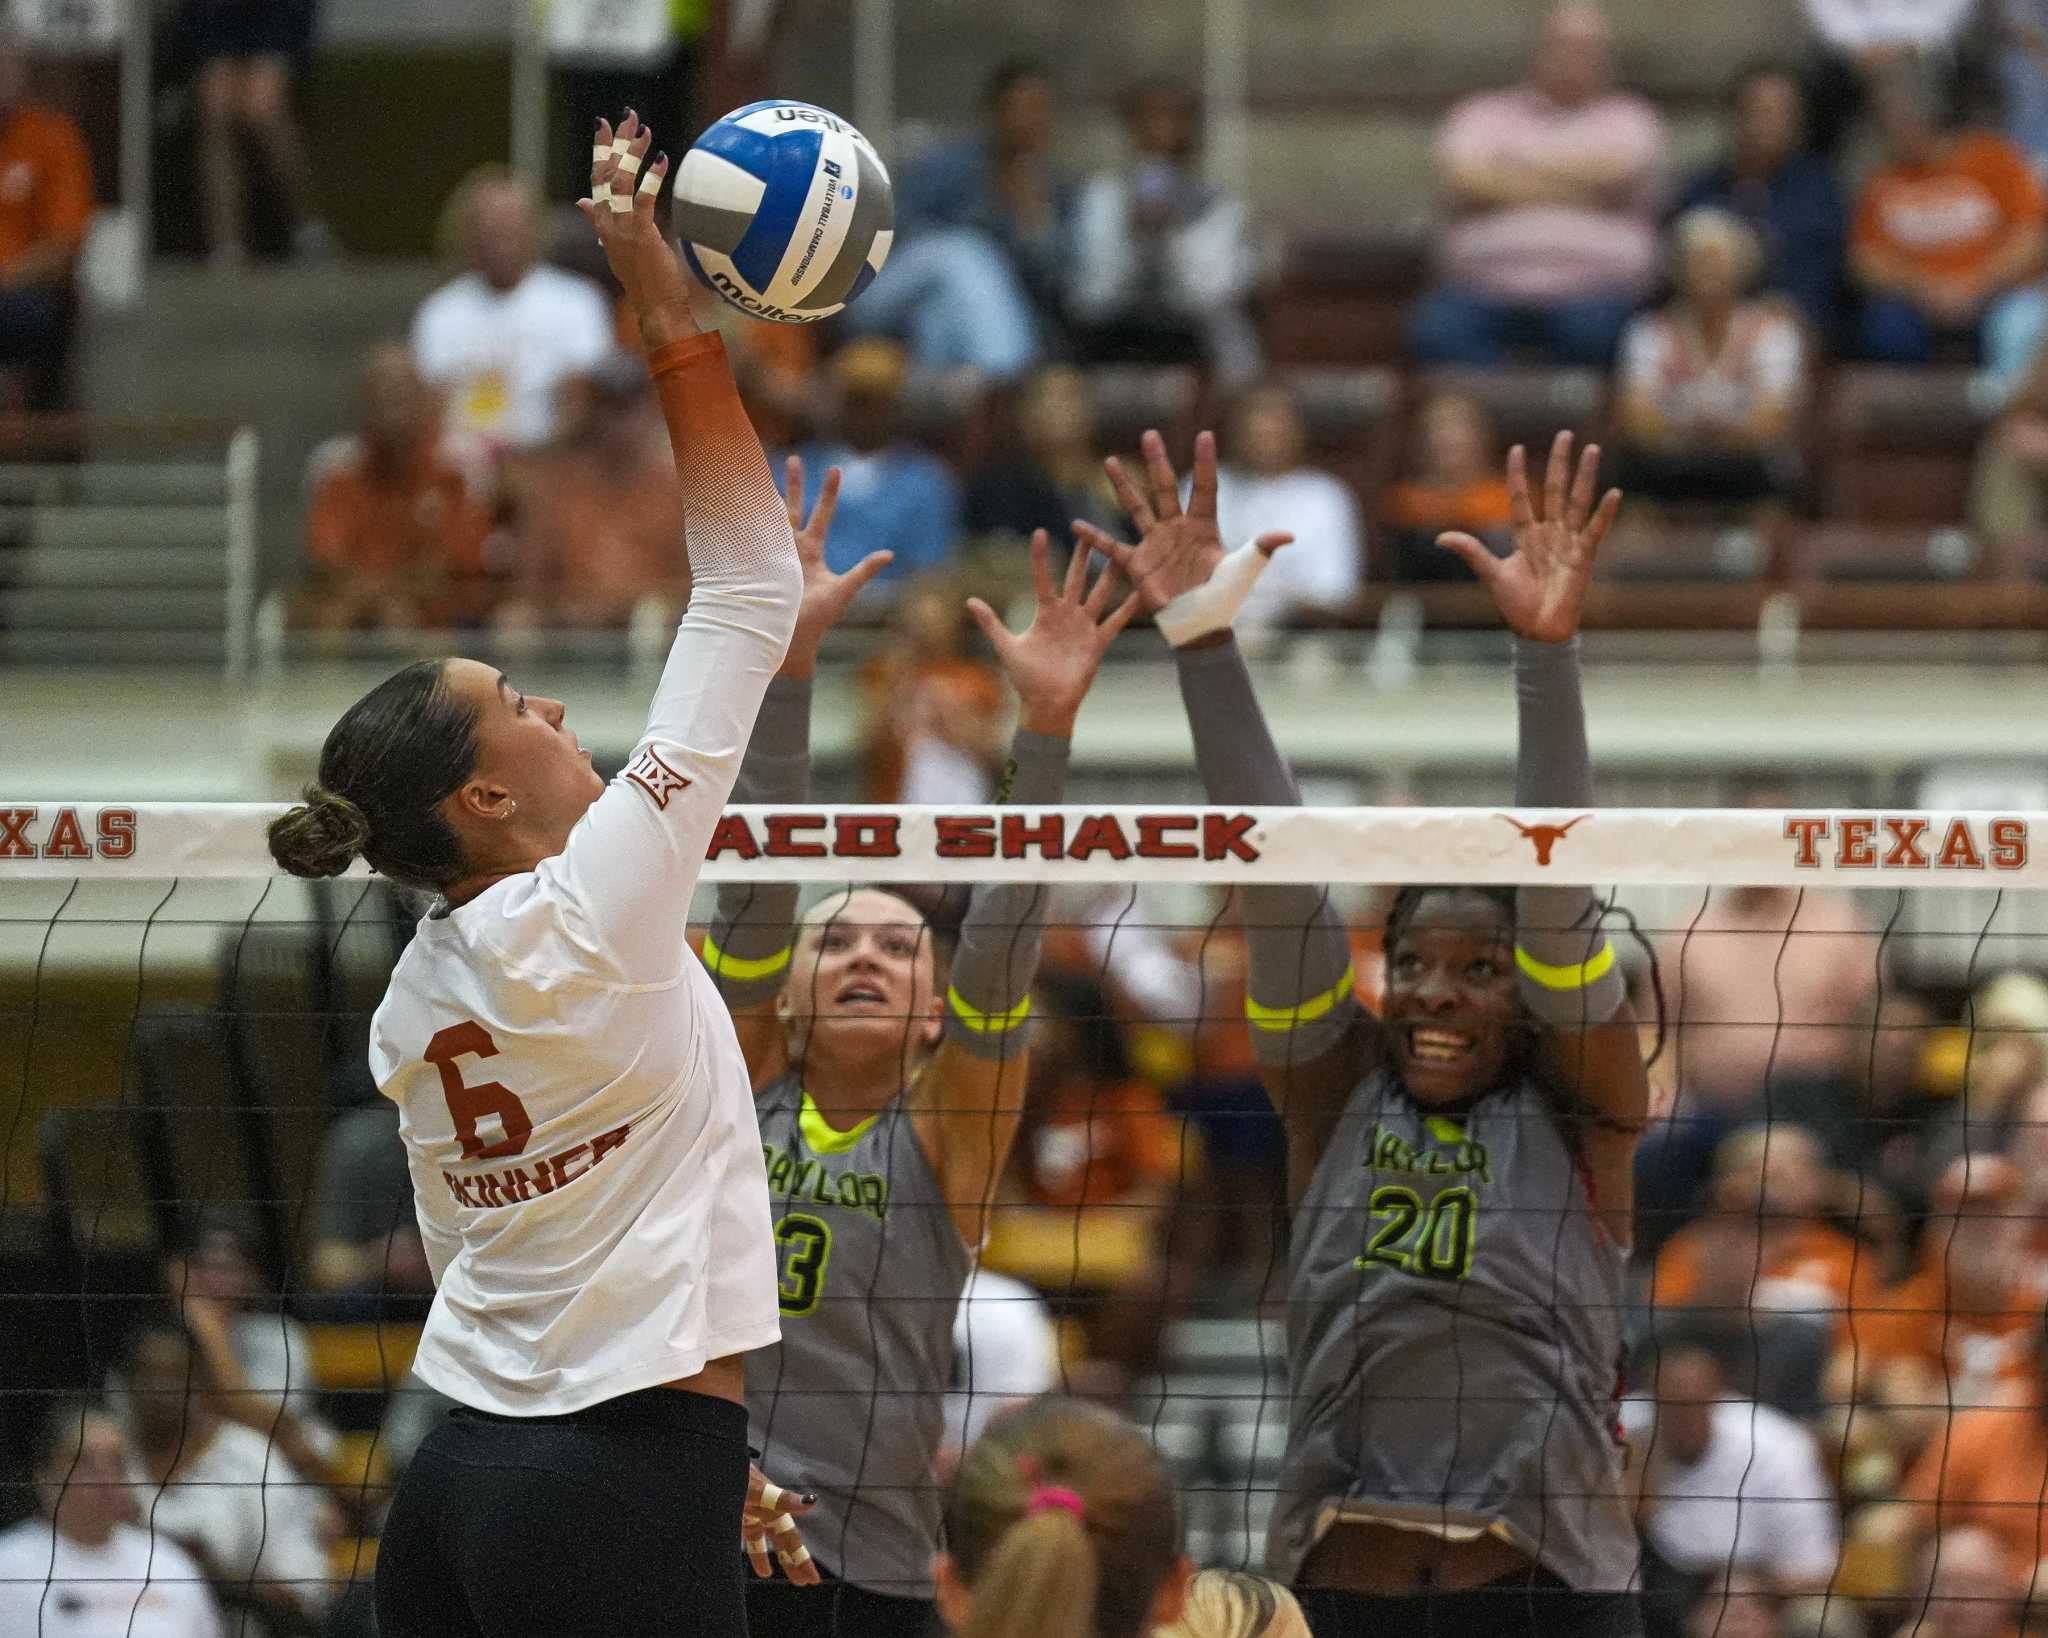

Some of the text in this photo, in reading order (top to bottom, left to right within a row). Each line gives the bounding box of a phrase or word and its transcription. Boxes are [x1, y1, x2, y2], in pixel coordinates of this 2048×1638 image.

[790, 179, 837, 287] VOLLEYBALL CHAMPIONSHIP
[935, 814, 1261, 862] SHACK
[1783, 815, 2028, 870] TEXAS
[423, 1020, 534, 1160] 6
[774, 1213, 832, 1317] 3
[1353, 1185, 1478, 1281] 20
